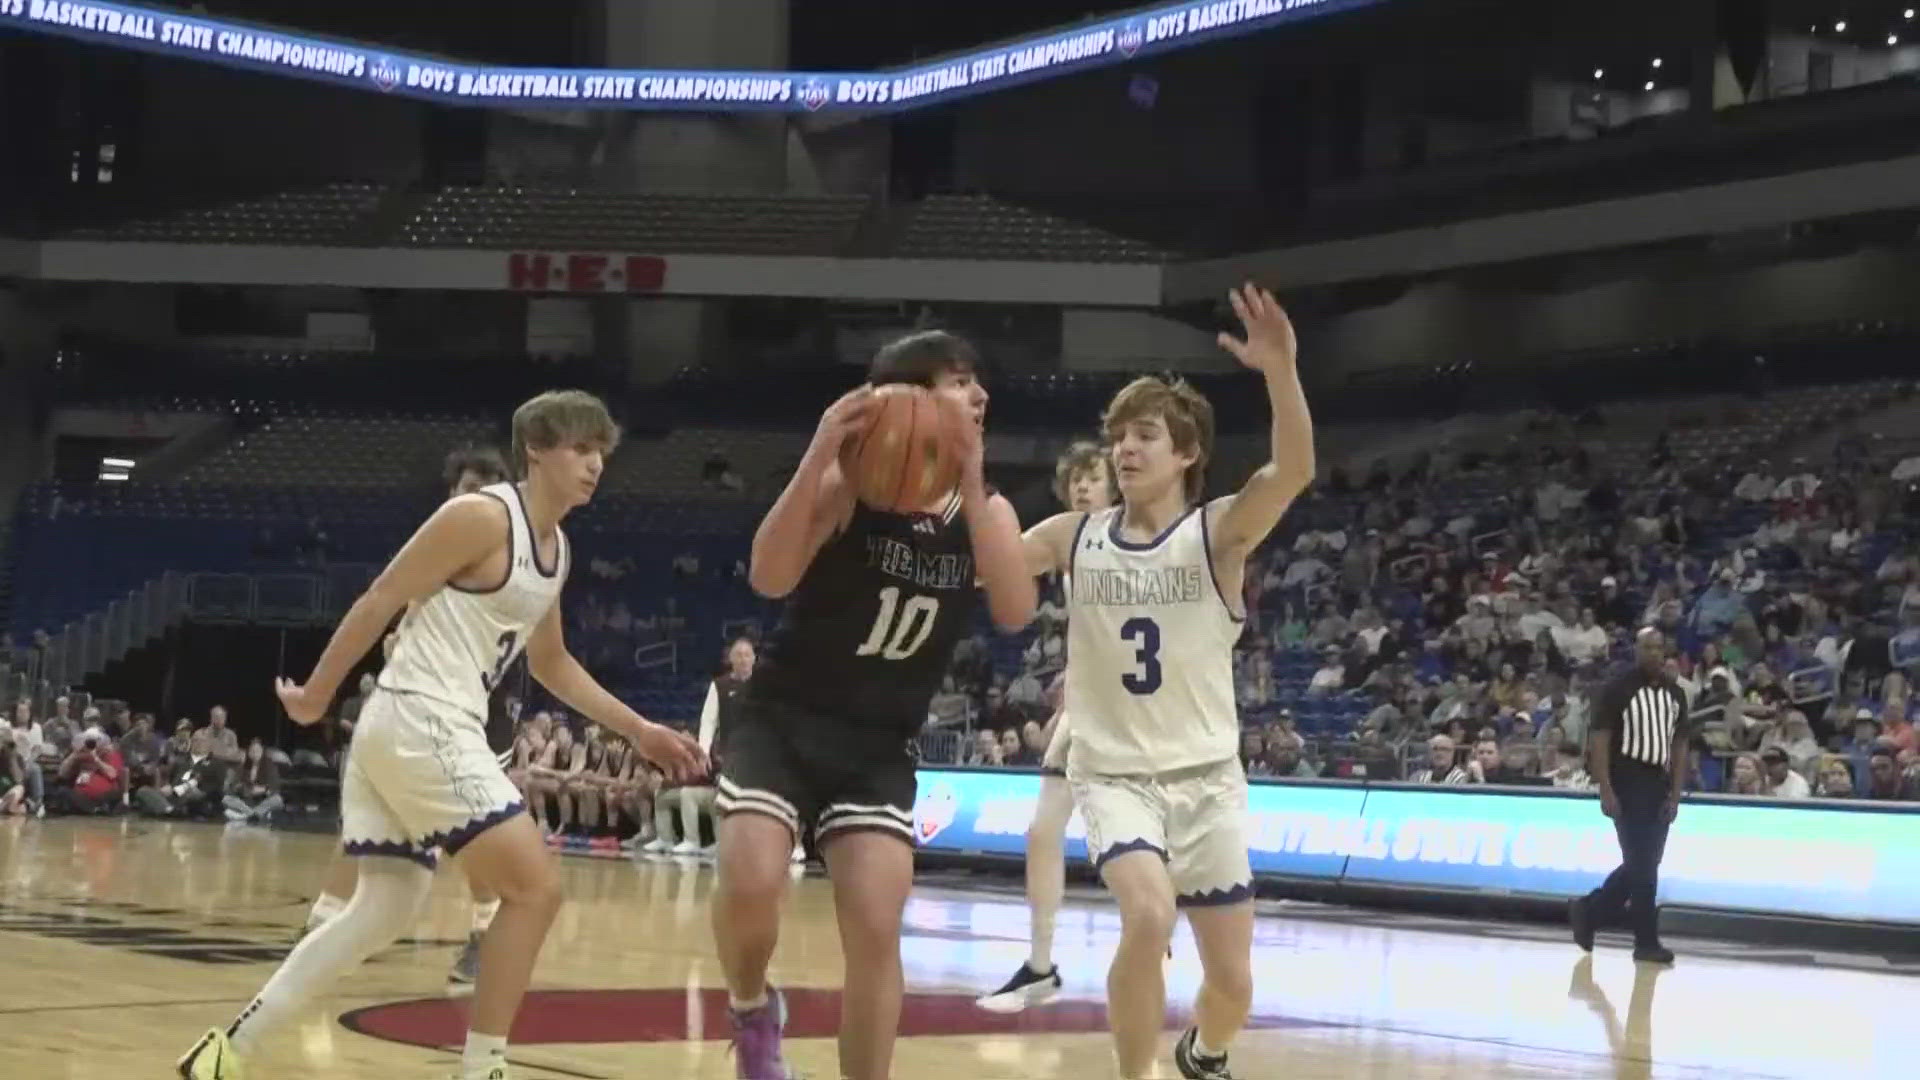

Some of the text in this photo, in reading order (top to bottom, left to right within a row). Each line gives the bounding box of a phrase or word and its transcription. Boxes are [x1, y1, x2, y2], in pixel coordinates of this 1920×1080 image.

[29, 0, 155, 40] BASKETBALL
[160, 20, 214, 50] STATE
[217, 31, 366, 77] CHAMPIONSHIPS
[1146, 0, 1282, 42] BOYS BASKETBALL
[406, 64, 791, 102] BOYS BASKETBALL STATE CHAMPIONSHIPS
[836, 28, 1115, 103] BOYS BASKETBALL STATE CHAMPIONSHIPS
[1079, 564, 1202, 606] INDIANS
[855, 586, 940, 661] 10
[1120, 616, 1161, 696] 3
